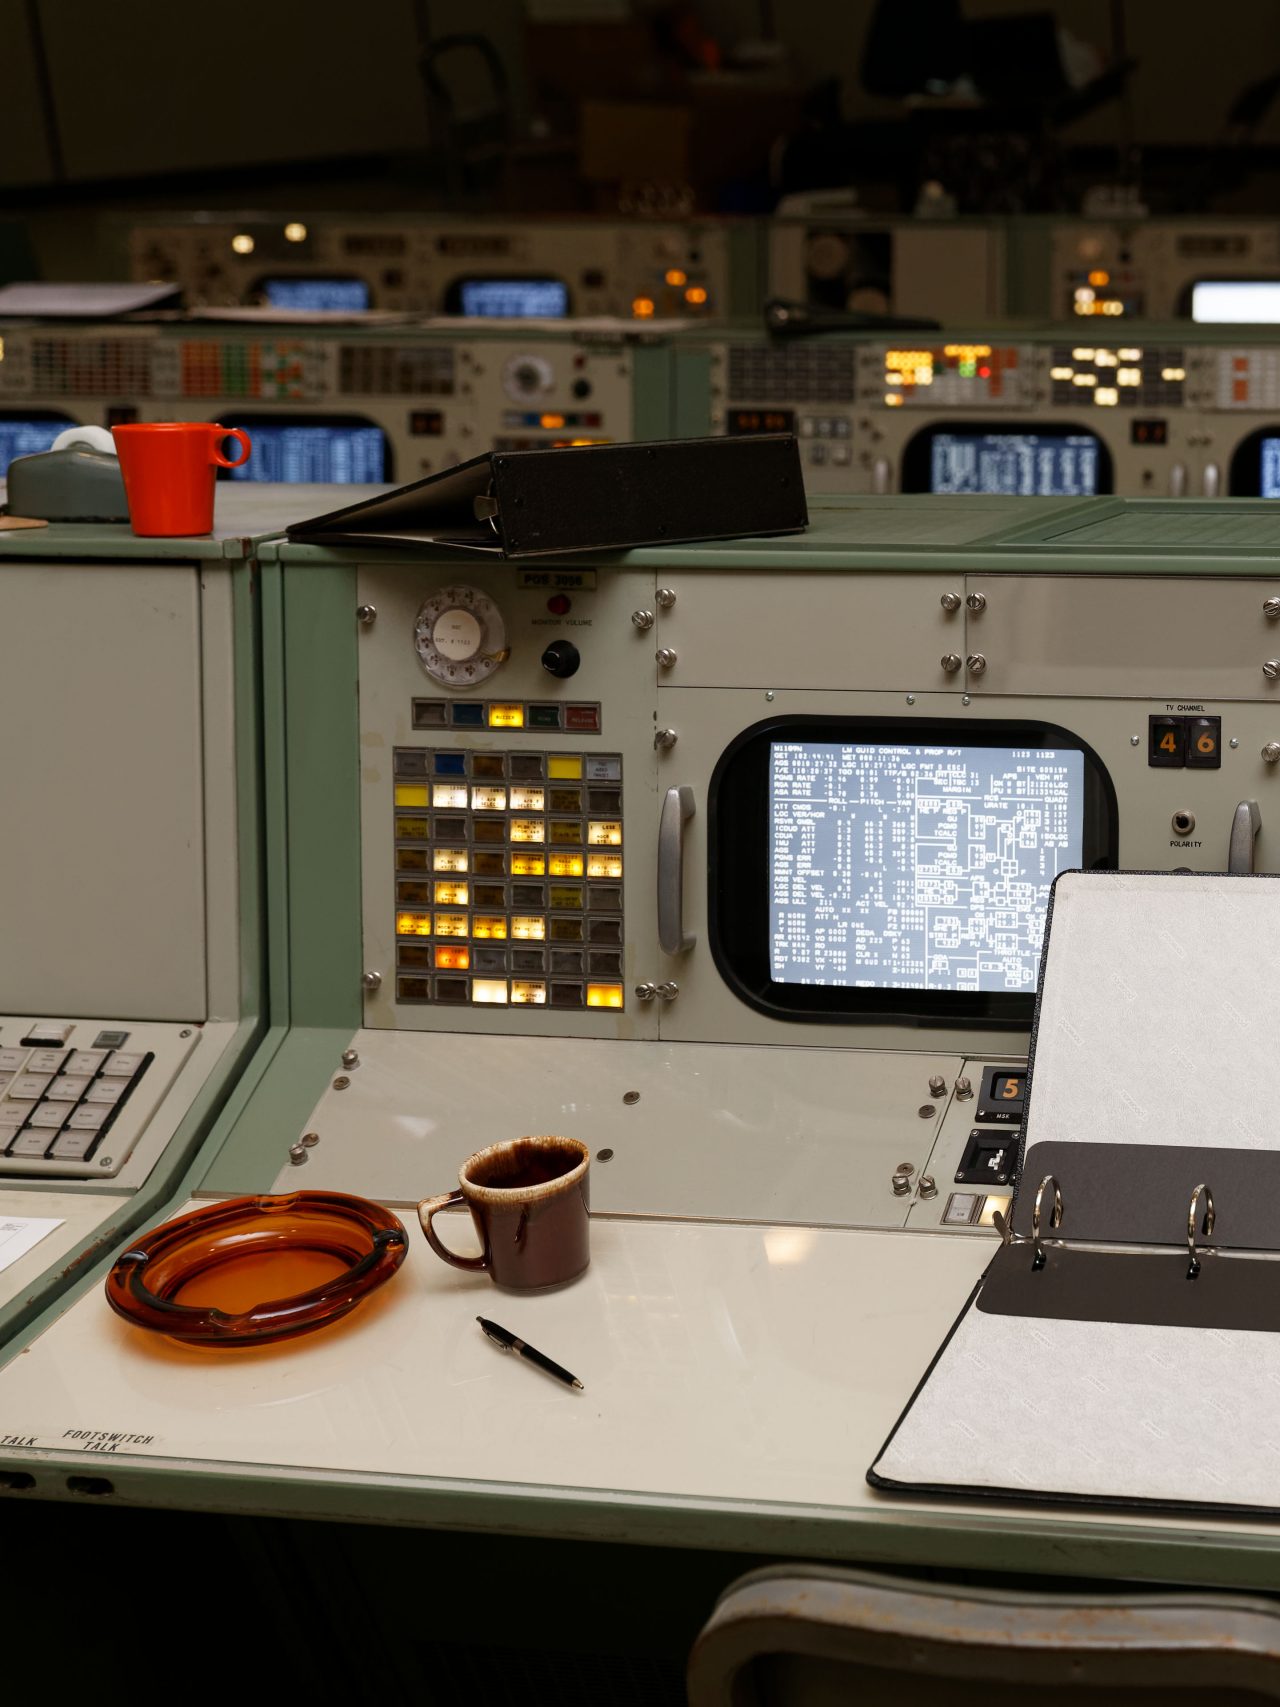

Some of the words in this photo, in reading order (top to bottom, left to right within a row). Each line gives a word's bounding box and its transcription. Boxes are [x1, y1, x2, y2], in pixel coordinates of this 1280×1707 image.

[1160, 732, 1176, 753] 4
[1197, 731, 1215, 753] 6
[1003, 1079, 1018, 1099] 5
[1, 1435, 38, 1446] TALK
[62, 1429, 155, 1445] FOOTSWITCH
[83, 1441, 120, 1452] TALK
